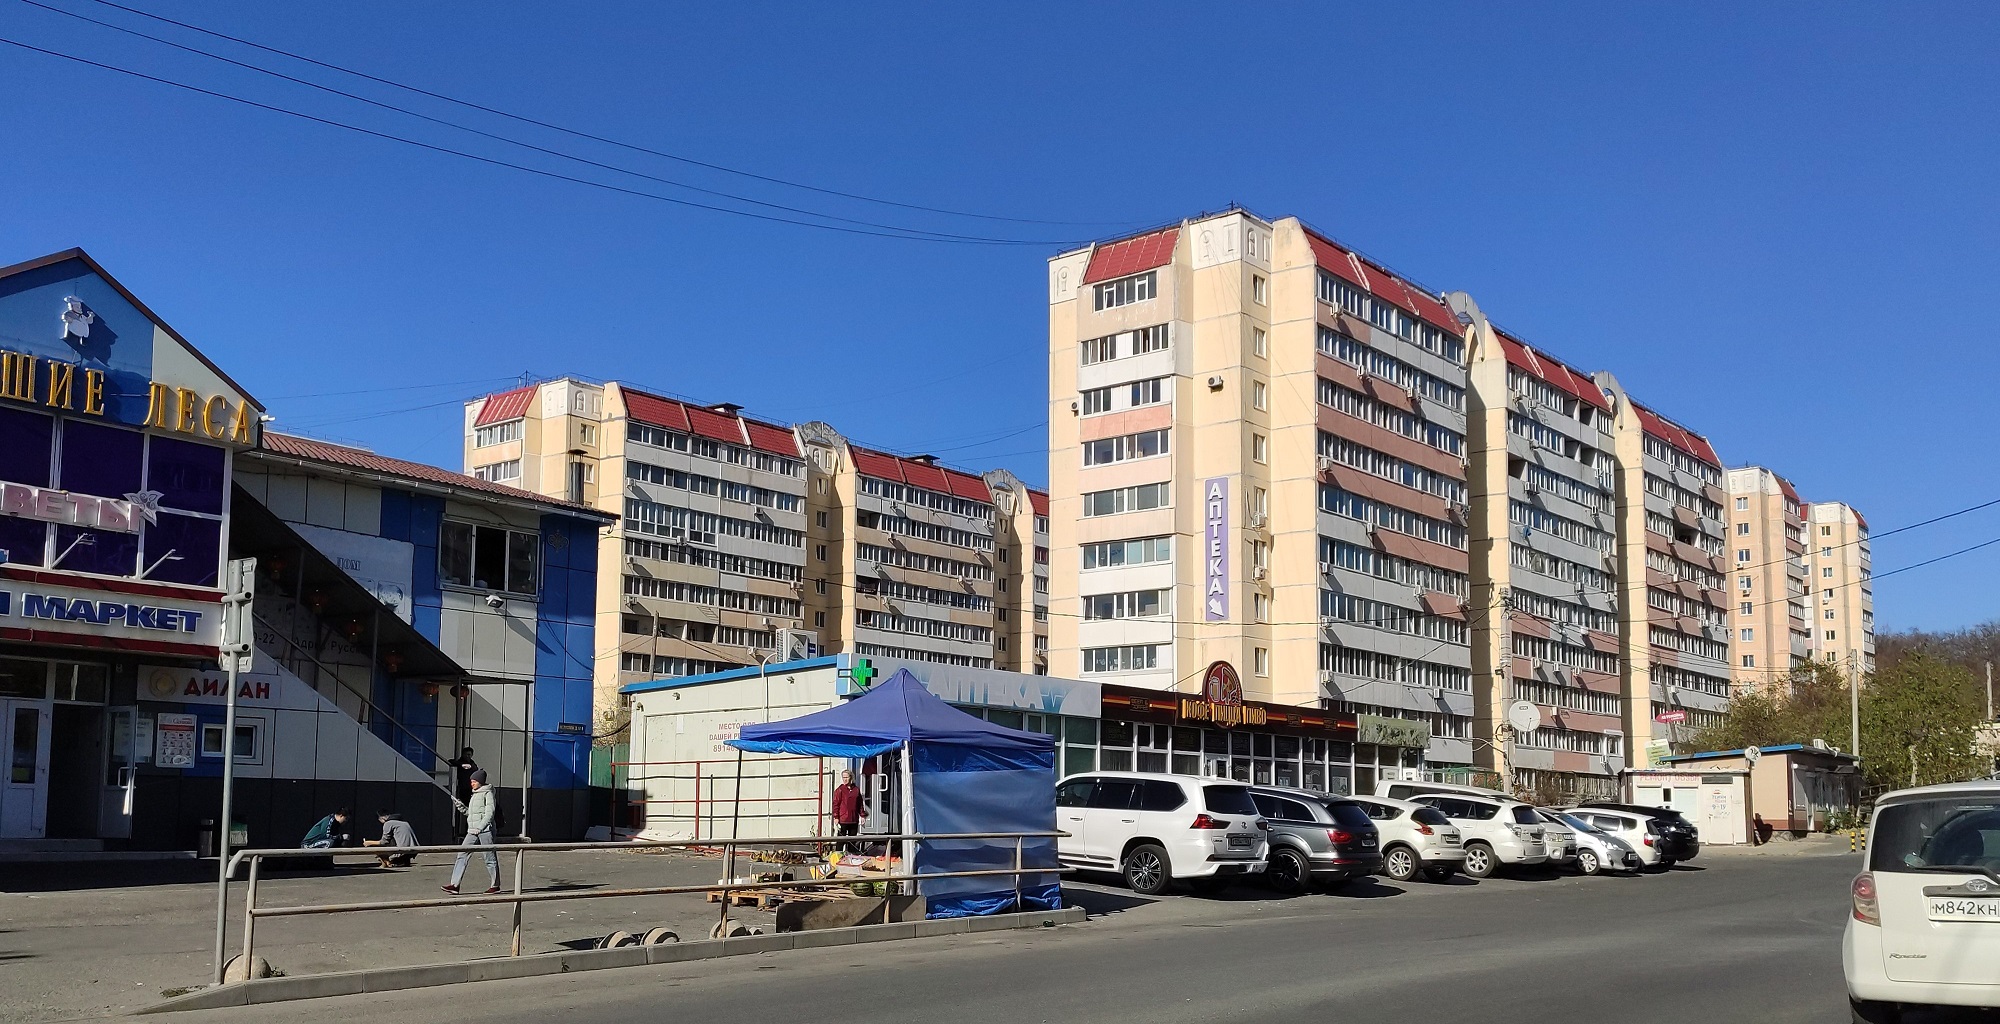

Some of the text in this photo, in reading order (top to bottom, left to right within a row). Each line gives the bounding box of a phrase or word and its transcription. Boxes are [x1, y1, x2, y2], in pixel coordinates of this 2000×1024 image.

[143, 380, 251, 444] ЛЕСА
[0, 482, 140, 533] ВЕТЫ
[1208, 482, 1224, 596] АПТЕКА
[21, 591, 203, 634] МАРКЕТ
[927, 667, 1045, 709] АПТЕКА
[718, 722, 741, 730] МЕСТО
[1186, 700, 1210, 721] КОФЕ
[1215, 705, 1241, 727] ПИЦЦА
[1246, 706, 1267, 725] ПИВО
[1935, 900, 1997, 915] М842КН
